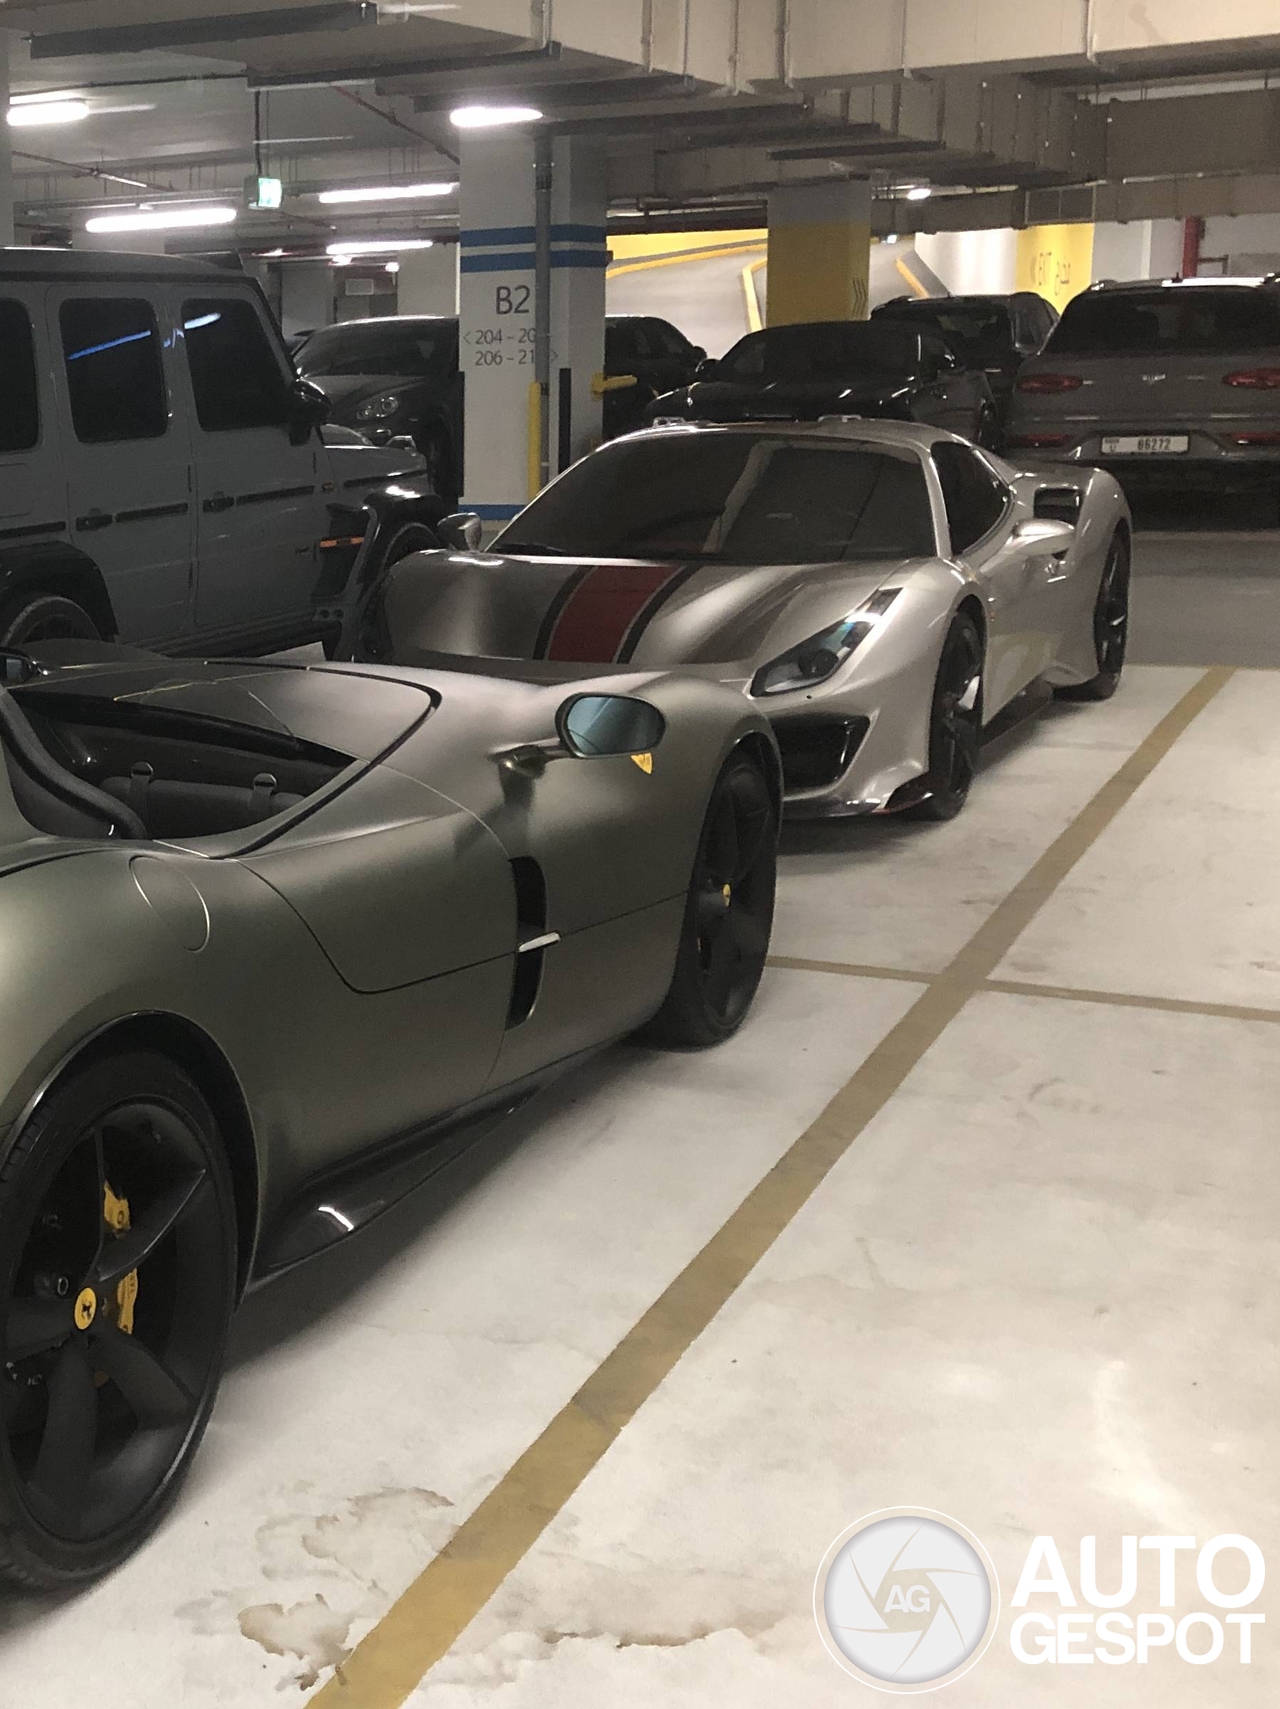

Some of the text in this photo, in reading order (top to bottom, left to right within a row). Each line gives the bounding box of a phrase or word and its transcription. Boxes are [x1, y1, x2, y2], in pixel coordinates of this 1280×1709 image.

[495, 284, 531, 315] B2
[475, 328, 503, 345] 204
[518, 327, 536, 344] 20
[475, 350, 503, 366] 206
[518, 348, 535, 365] 21
